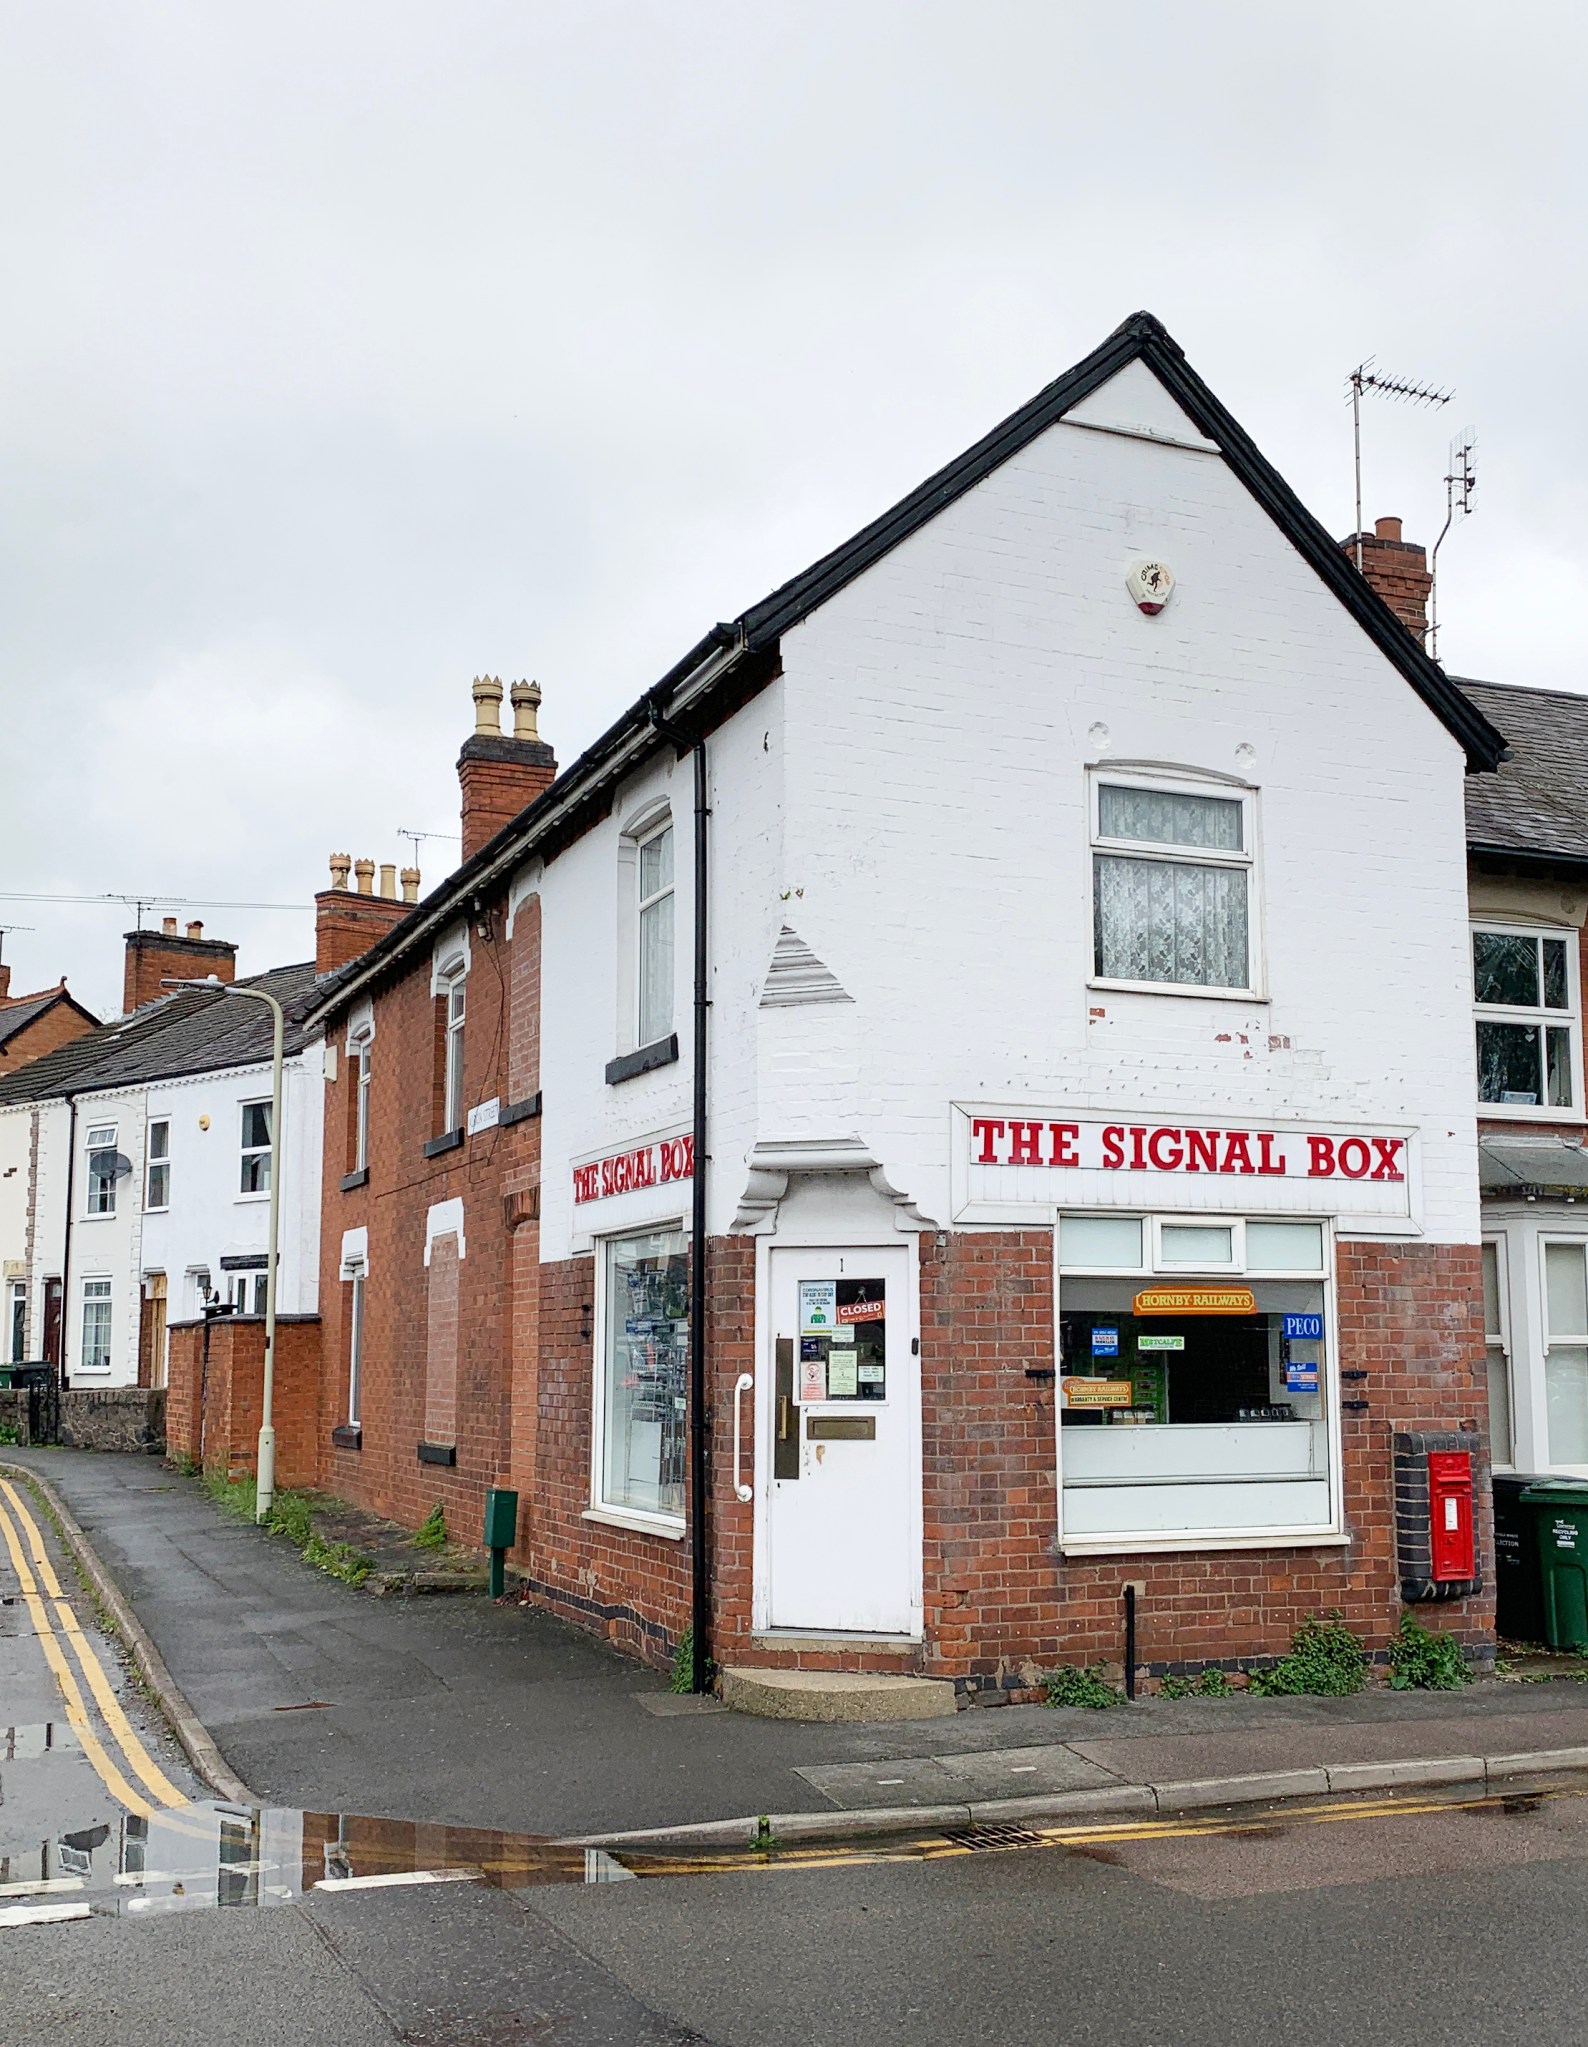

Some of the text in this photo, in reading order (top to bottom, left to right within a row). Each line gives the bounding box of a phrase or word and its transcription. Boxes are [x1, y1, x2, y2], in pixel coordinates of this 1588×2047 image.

[1141, 564, 1158, 581] CRIME
[973, 1119, 1405, 1181] THE SIGNAL BOX
[573, 1134, 694, 1204] THE SIGNAL BOX
[1141, 1294, 1251, 1306] HORNBY RAILWAYS
[840, 1302, 881, 1316] CLOSED
[1286, 1317, 1320, 1335] PECO
[1140, 1338, 1182, 1346] METCALFE
[1552, 1528, 1579, 1536] RECYCLING
